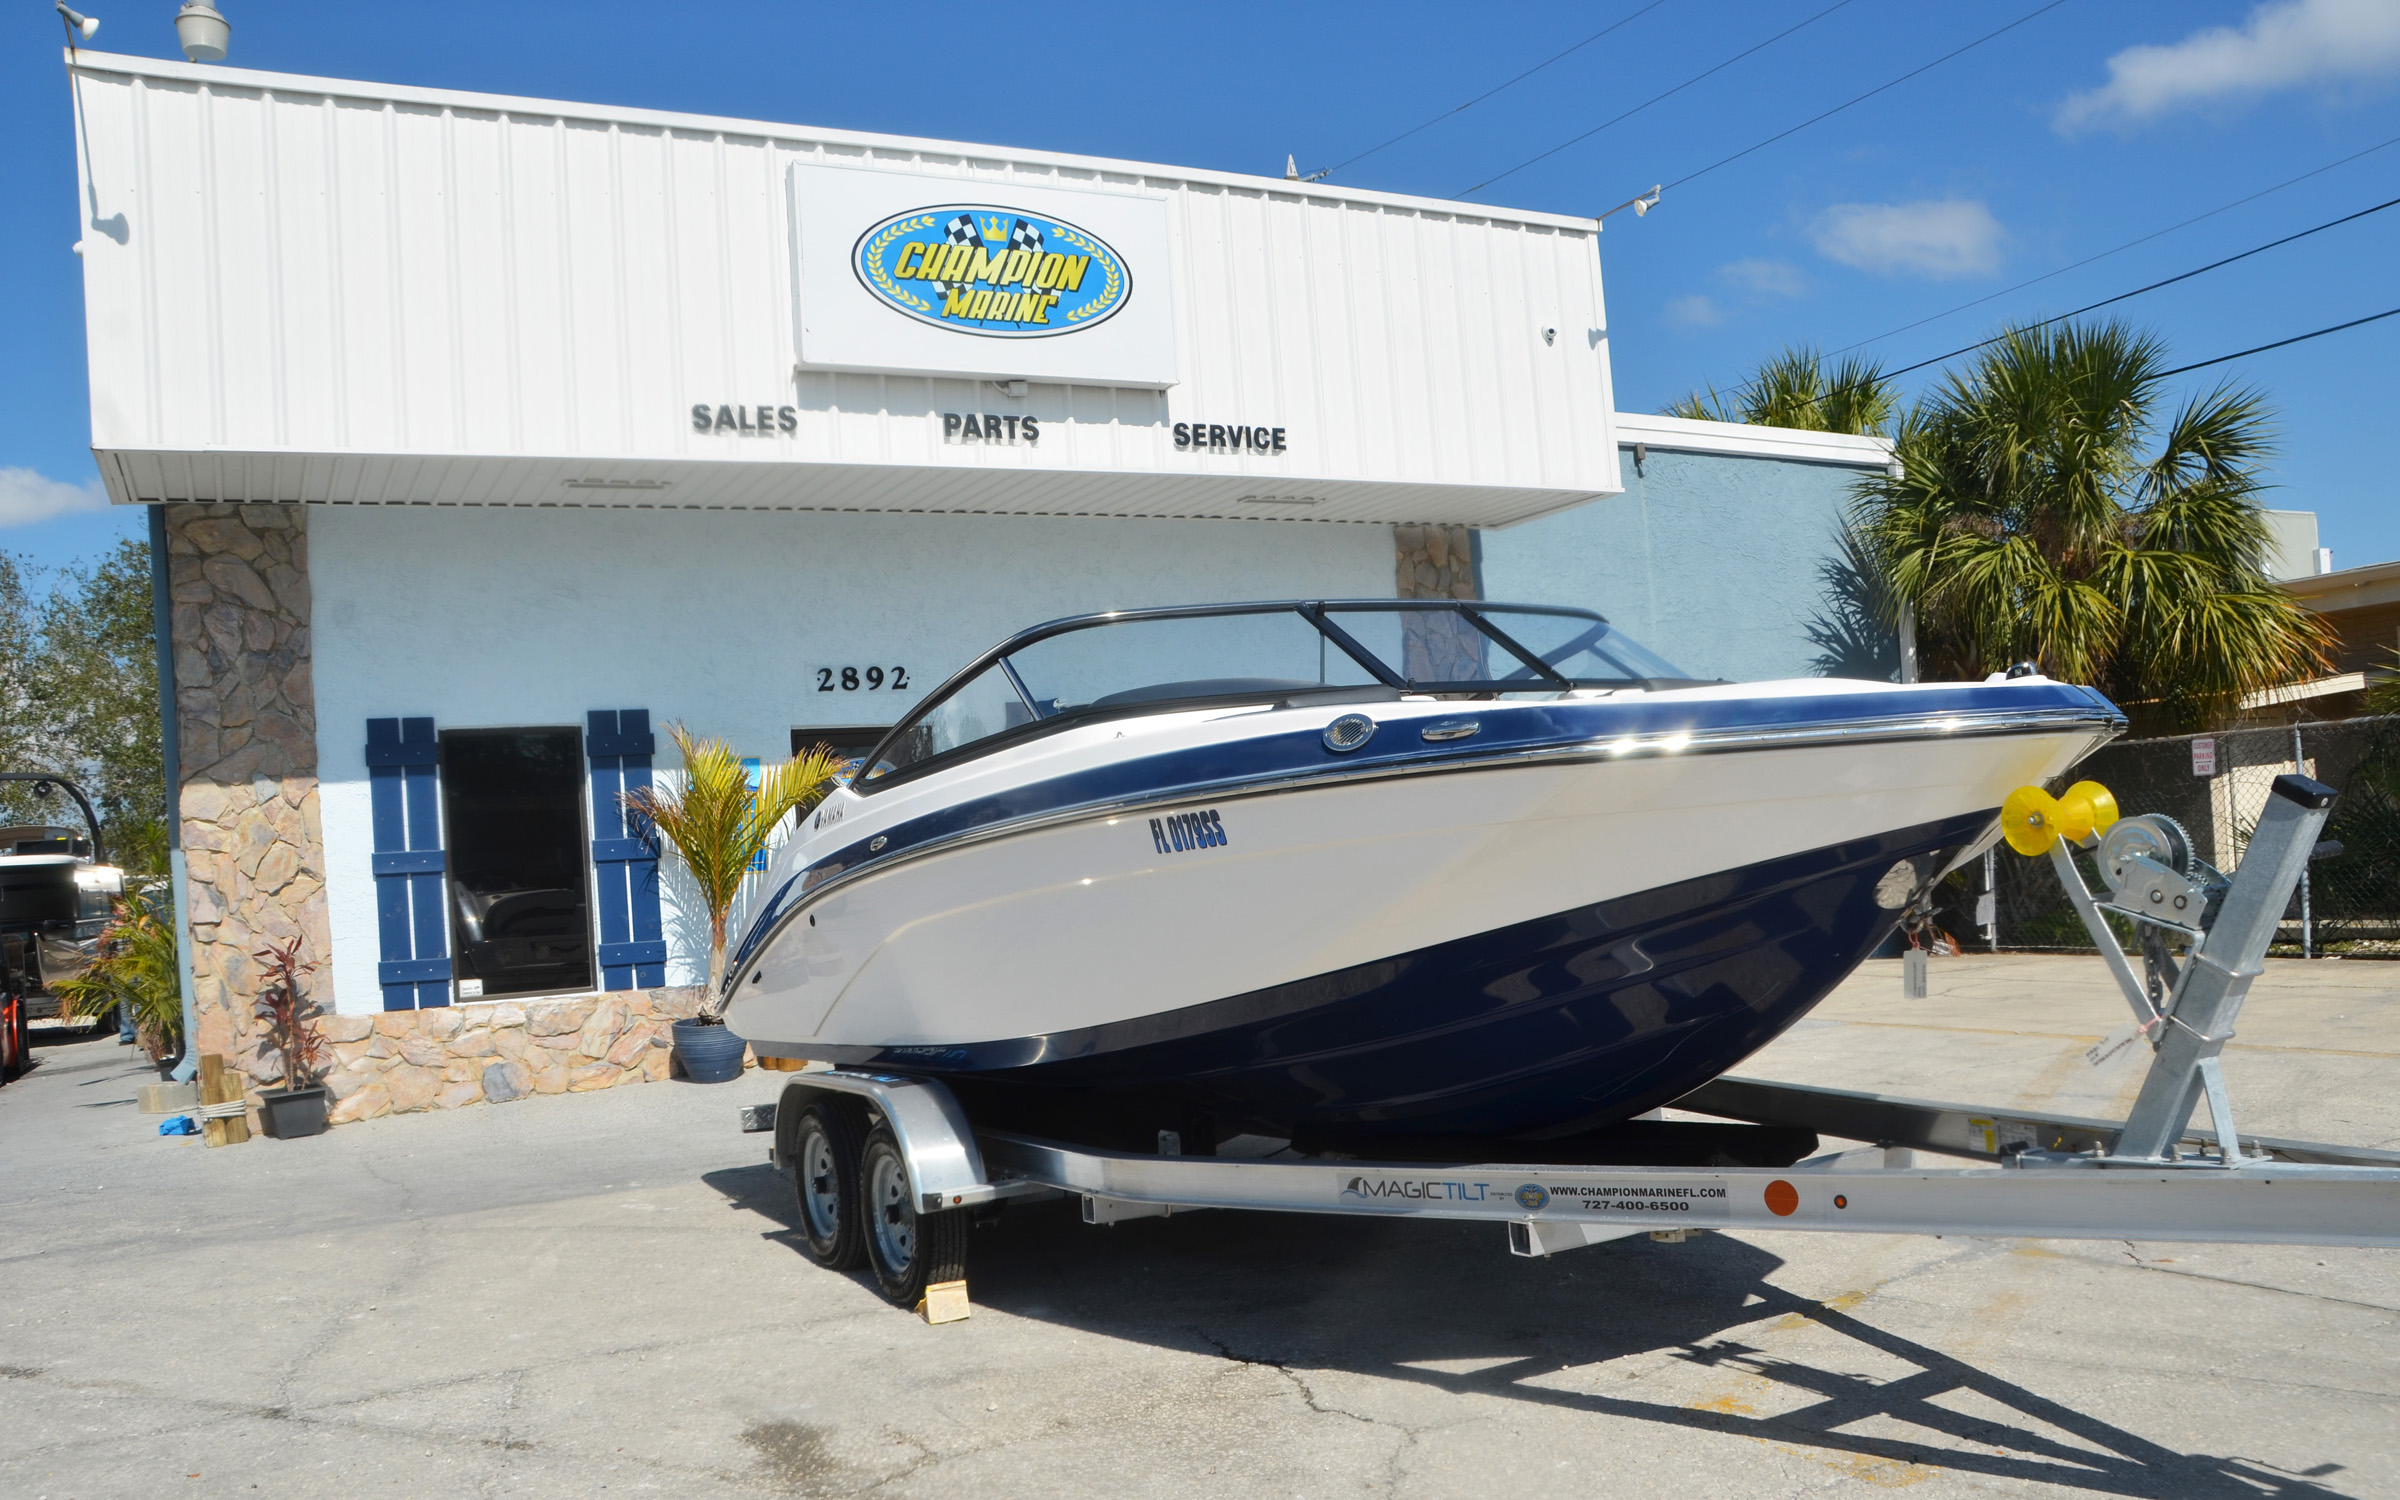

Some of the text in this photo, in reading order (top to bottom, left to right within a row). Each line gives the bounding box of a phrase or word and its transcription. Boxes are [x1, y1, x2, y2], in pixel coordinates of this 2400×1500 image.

[893, 241, 1091, 292] CHAMPION
[940, 287, 1059, 325] MARINE
[691, 403, 798, 432] SALES
[943, 413, 1040, 441] PARTS
[1173, 422, 1288, 451] SERVICE
[817, 666, 909, 692] 2892
[2193, 752, 2213, 760] PARKING
[1149, 809, 1227, 854] FL 0179SS
[1362, 1179, 1490, 1201] MAGICTILT
[1549, 1186, 1726, 1198] WWW.CHAMPIONMARINEFL.COM
[1582, 1200, 1689, 1211] 727-400-6500
